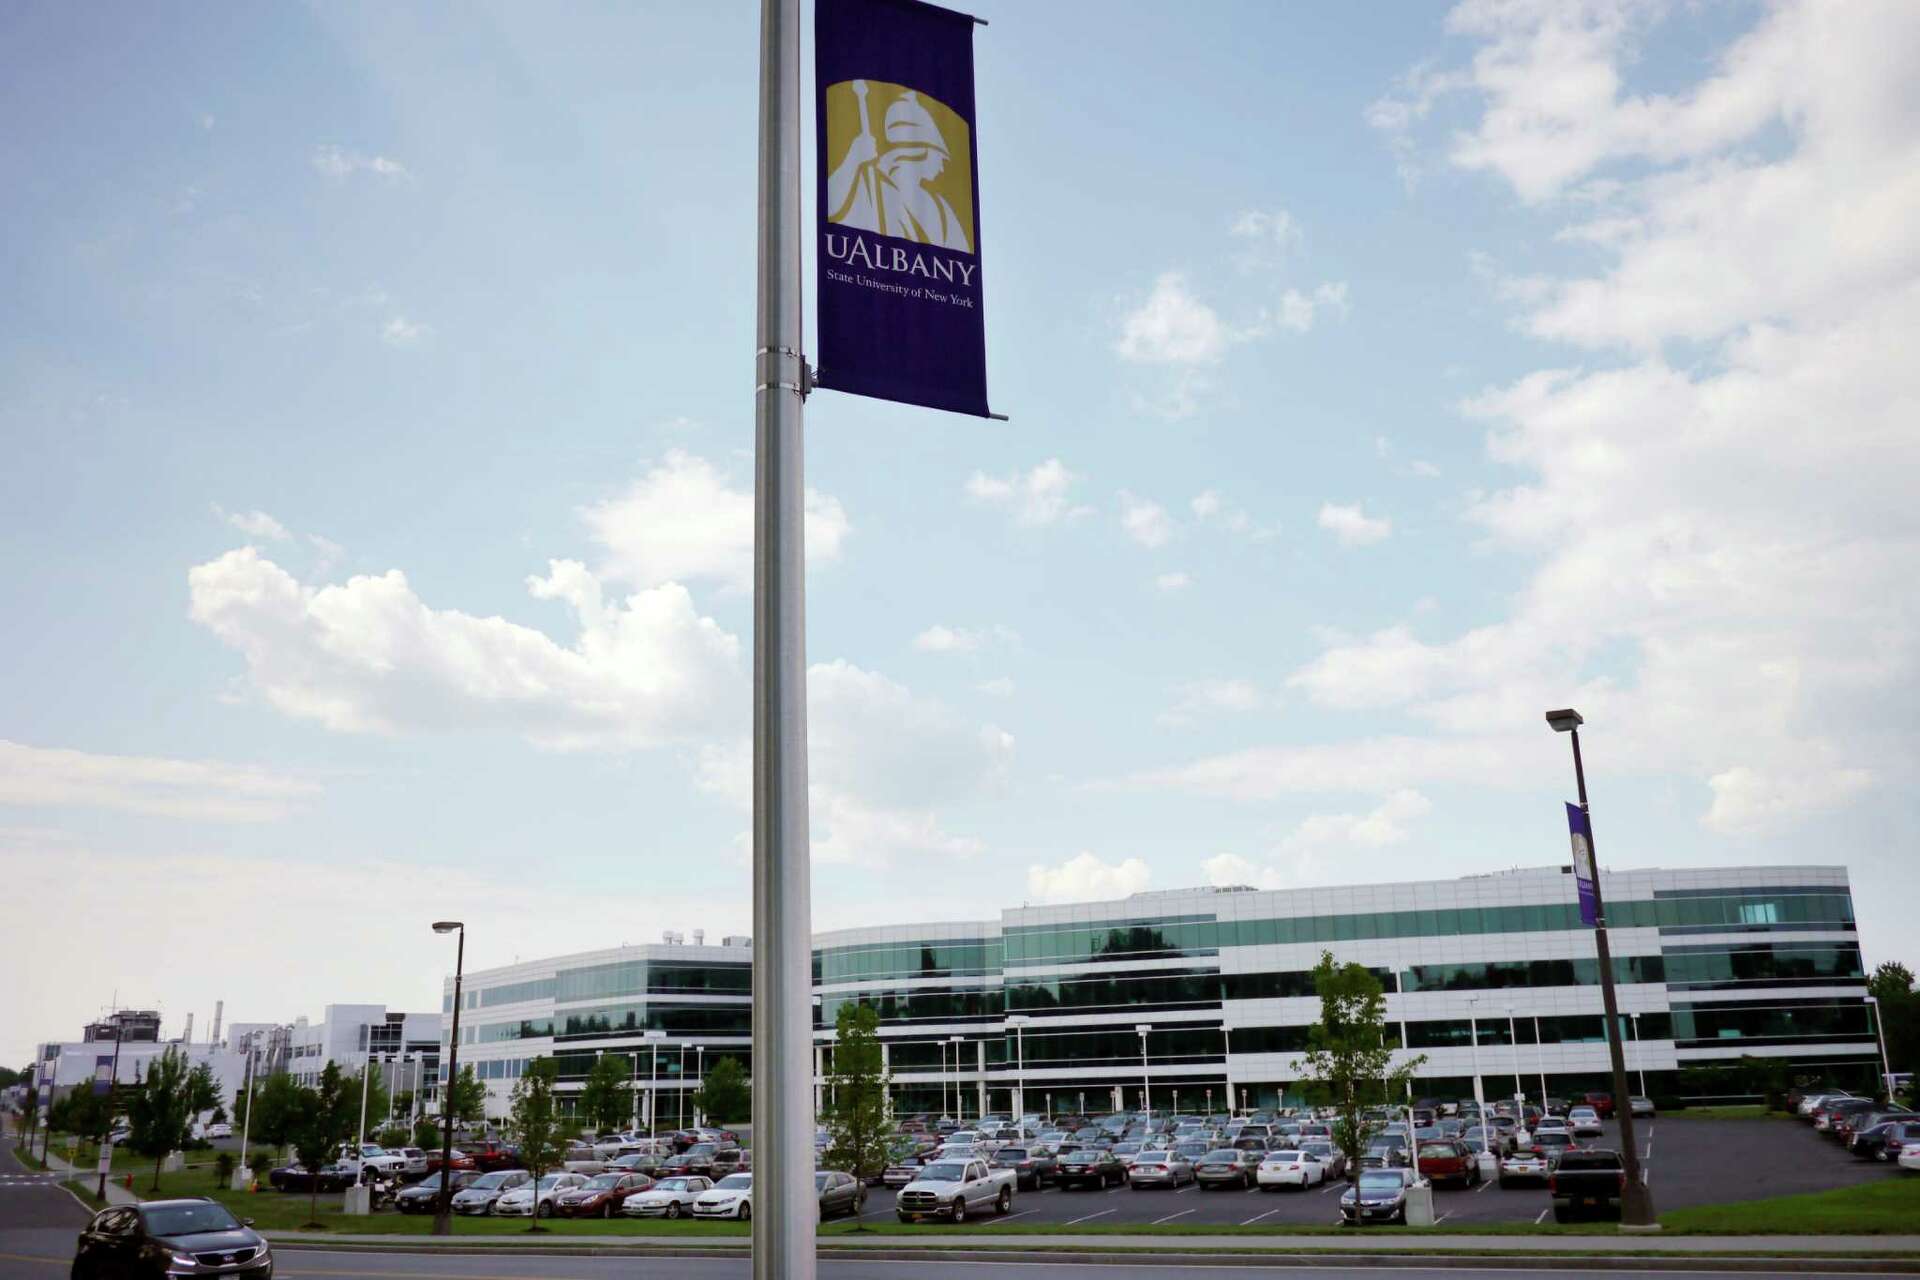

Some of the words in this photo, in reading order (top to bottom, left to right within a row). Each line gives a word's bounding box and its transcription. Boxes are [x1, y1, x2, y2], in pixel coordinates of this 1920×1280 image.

[825, 233, 975, 286] UALBANY
[827, 269, 853, 284] State
[857, 274, 909, 297] University
[911, 287, 922, 298] of
[924, 288, 947, 303] New
[950, 294, 974, 308] York
